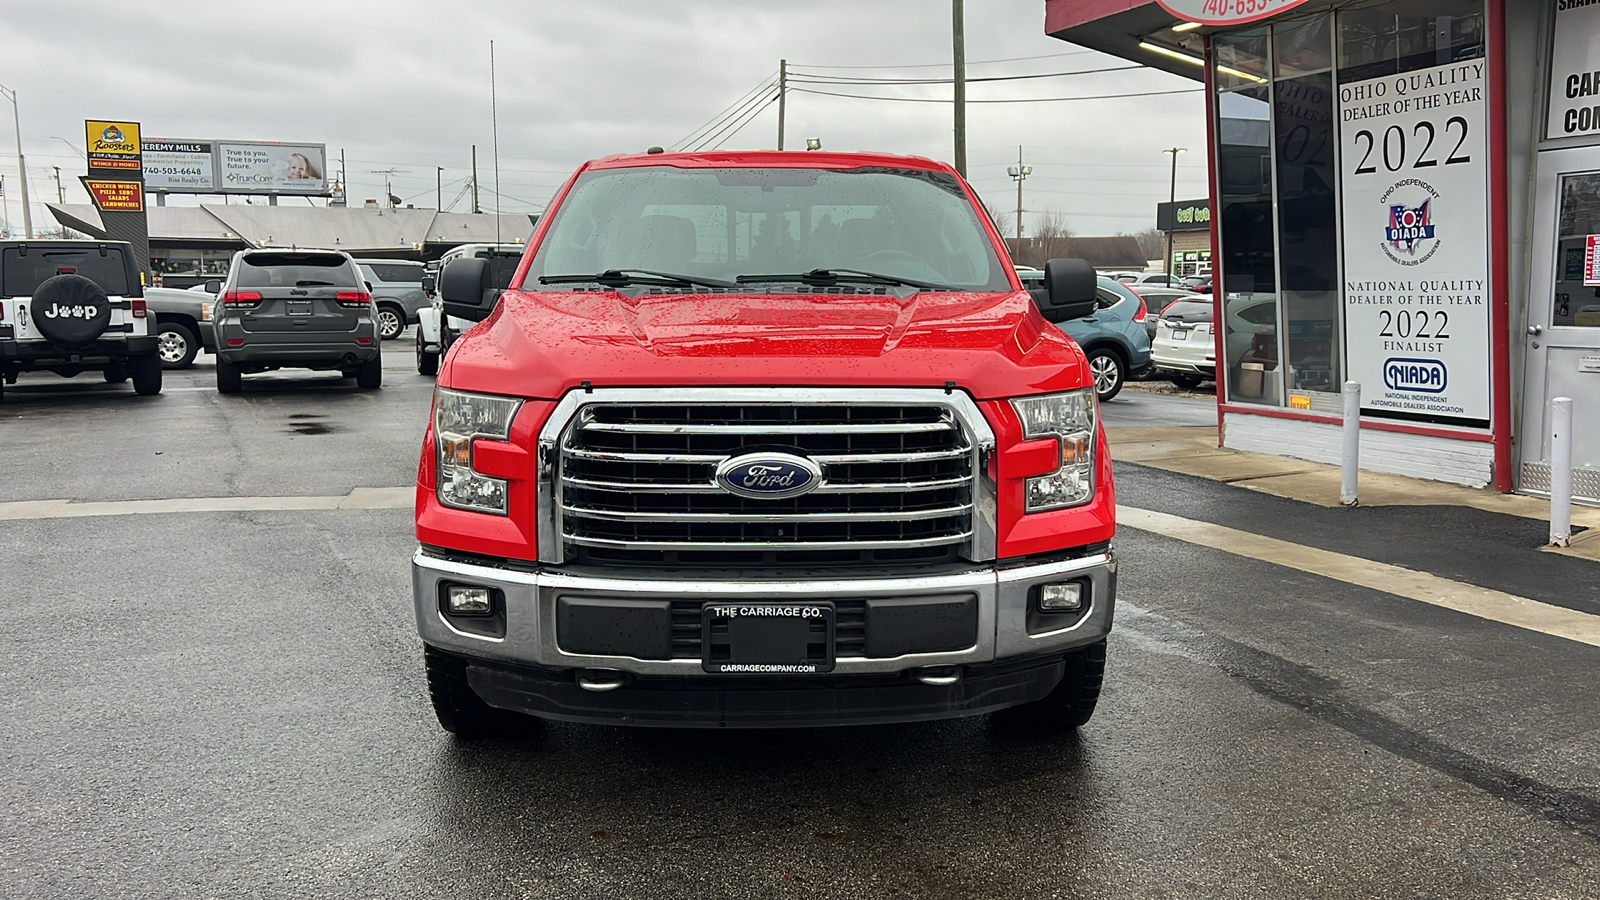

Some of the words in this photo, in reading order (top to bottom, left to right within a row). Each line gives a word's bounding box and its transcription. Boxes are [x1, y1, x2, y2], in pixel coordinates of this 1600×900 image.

[1341, 82, 1387, 103] OHIO
[1395, 63, 1483, 96] QUALITY
[1343, 102, 1391, 122] DEALER
[1393, 99, 1410, 114] OF
[1413, 94, 1440, 110] THE
[1443, 87, 1482, 105] YEAR
[93, 139, 135, 152] Roosters
[141, 143, 174, 151] JEREMY
[175, 144, 201, 152] MILLS
[1354, 116, 1471, 175] 2022
[143, 167, 202, 175] 740-503-6648
[1380, 186, 1395, 204] OHIO
[1394, 178, 1440, 200] INDEPENDENT
[1391, 227, 1427, 240] OIADA
[1380, 242, 1401, 264] AUTOMOBILE
[1419, 239, 1441, 264] ASSOCIATION
[1347, 281, 1414, 292] NATIONAL
[1420, 280, 1483, 293] QUALITY
[1349, 295, 1393, 304] DEALER
[1398, 295, 1413, 304] OF
[1418, 295, 1442, 304] THE
[1448, 295, 1482, 305] YEAR
[1379, 310, 1450, 339] 2022
[1384, 341, 1443, 352] FINALIST
[1388, 365, 1441, 386] NIADA
[1385, 392, 1410, 400] NATIONAL
[1411, 394, 1448, 403] INDEPENDENT
[1371, 399, 1402, 408] AUTOMOBILE
[1403, 401, 1426, 410] DEALERS
[1426, 404, 1464, 413] ASSOCIATION
[743, 465, 795, 487] Ford
[714, 607, 737, 617] THE
[740, 607, 800, 617] CARRIAGE
[802, 607, 822, 618] CO.
[721, 664, 815, 673] CARRIAGECOMPANY.COM
